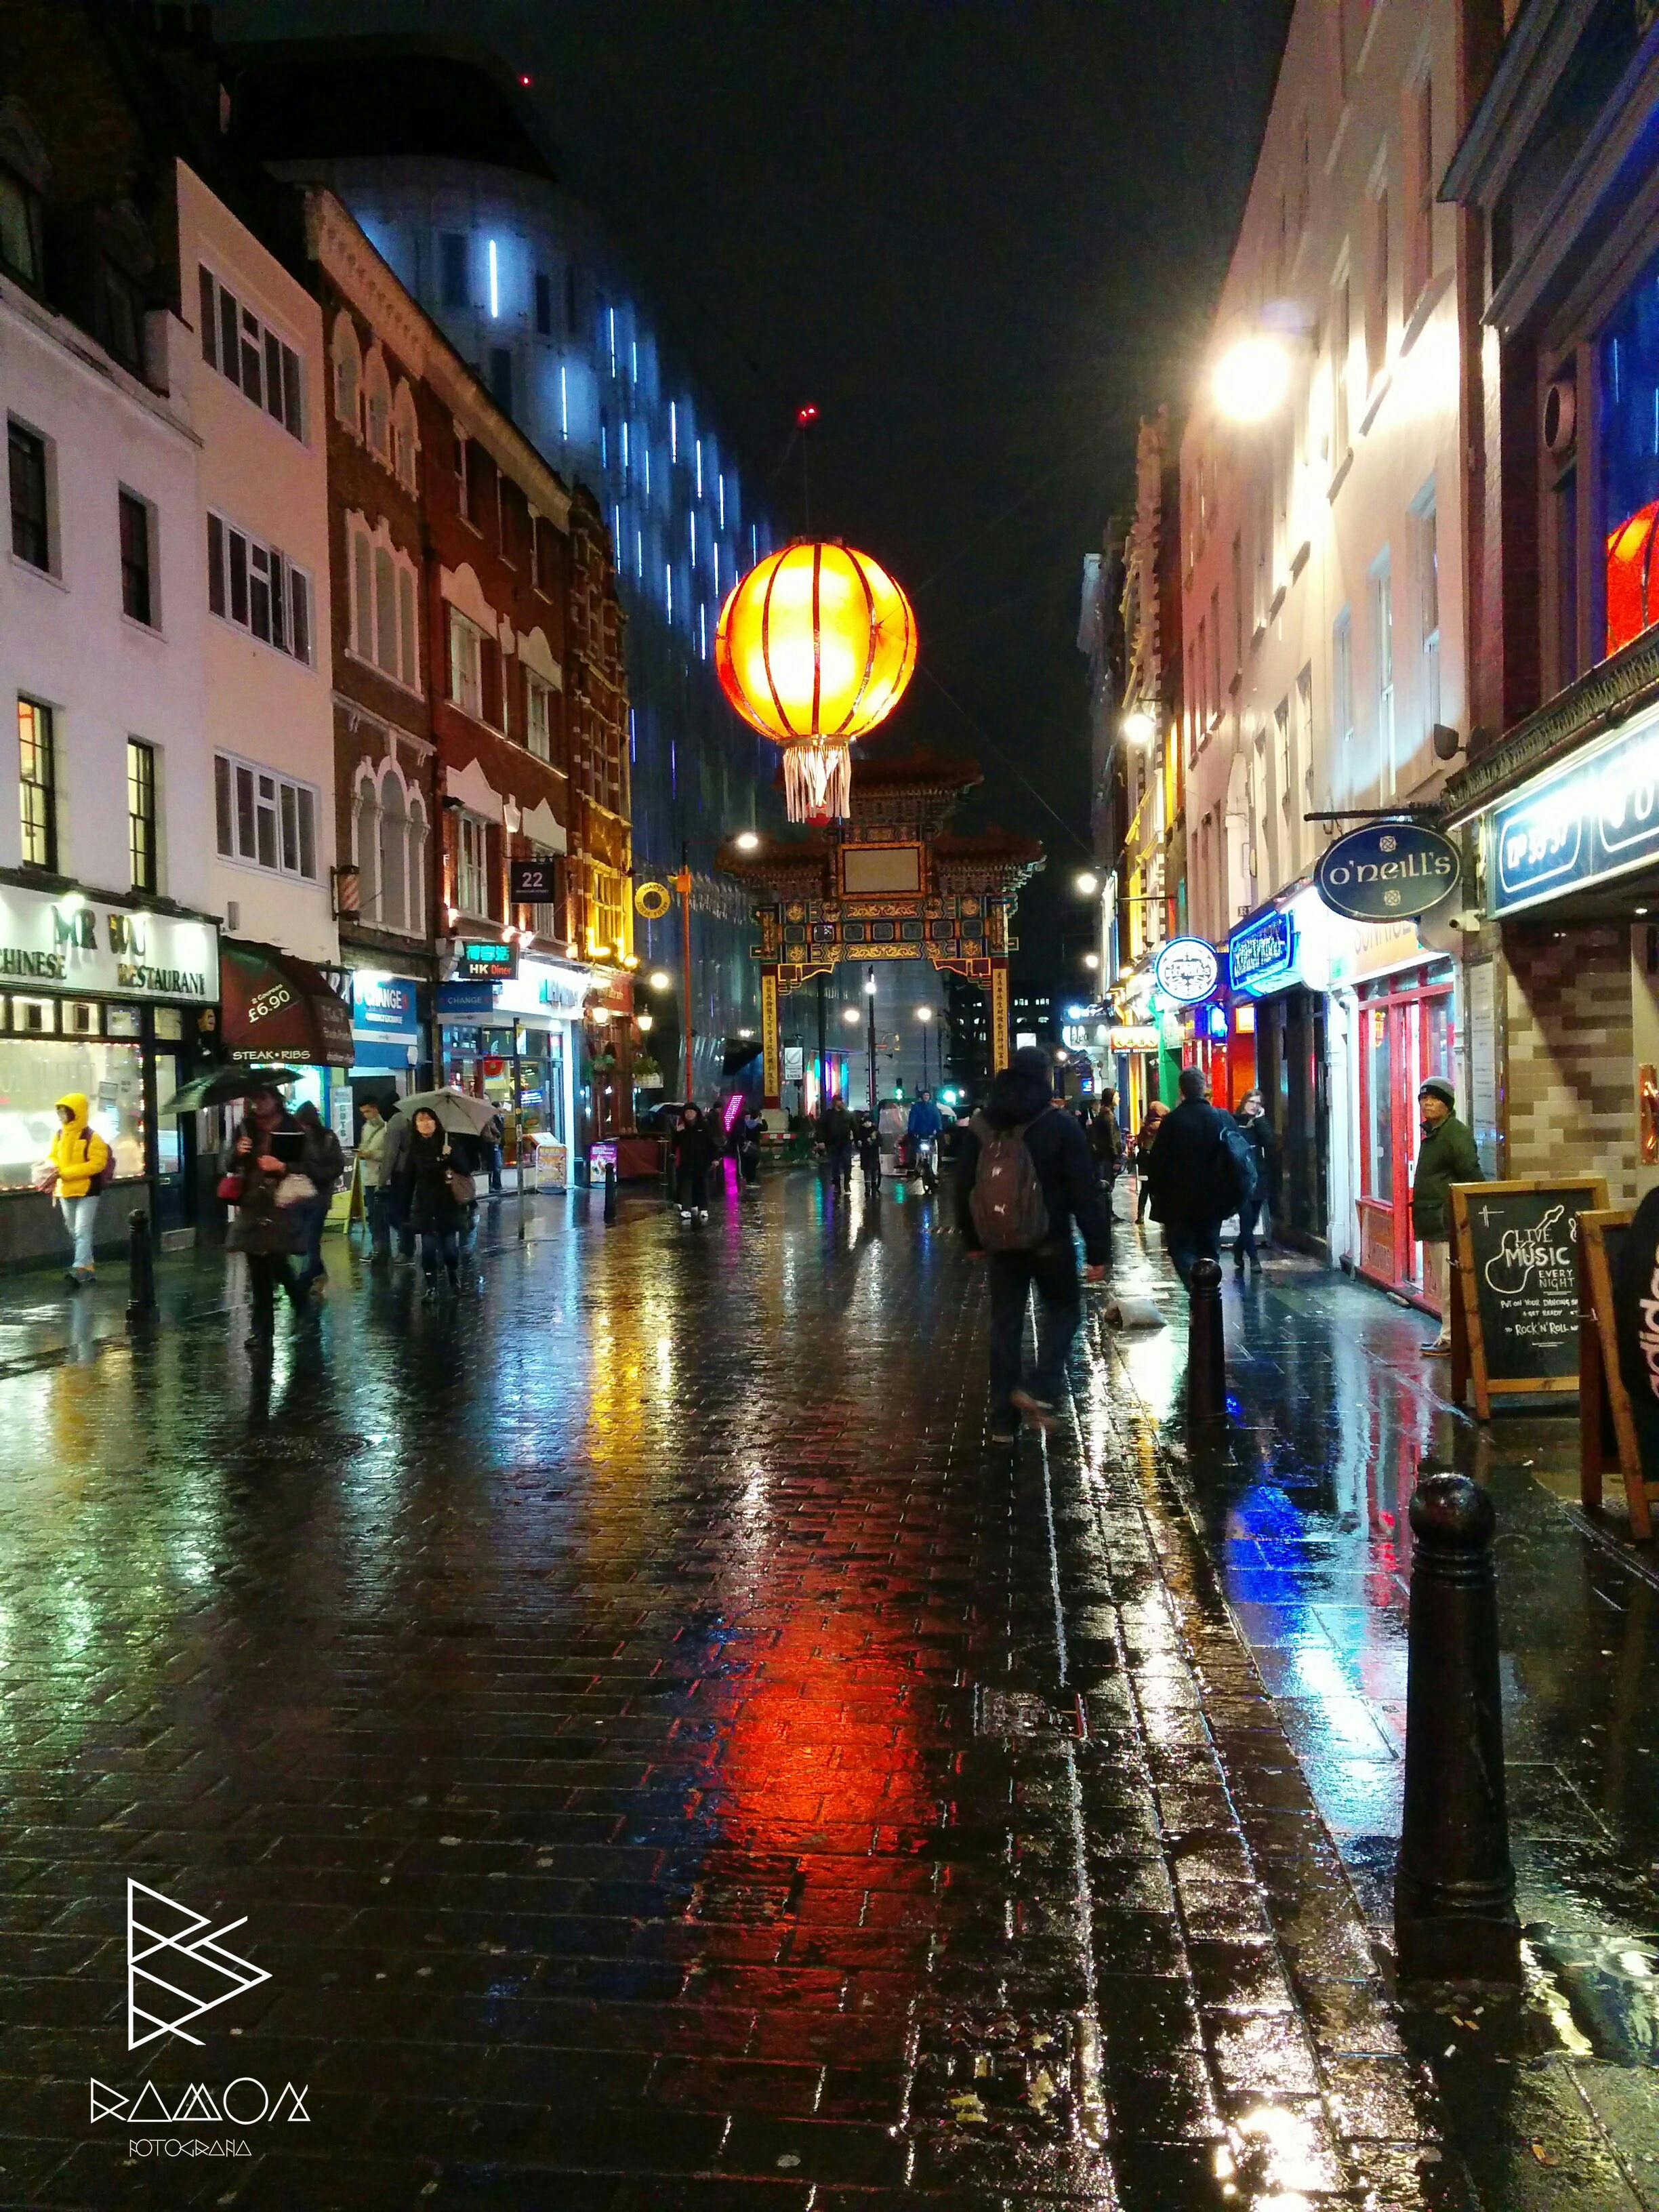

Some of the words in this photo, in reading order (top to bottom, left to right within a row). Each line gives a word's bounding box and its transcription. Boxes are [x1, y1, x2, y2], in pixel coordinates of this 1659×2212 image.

[522, 872, 543, 887] 22
[51, 905, 98, 949] MR
[0, 947, 67, 980] HINESE
[117, 963, 205, 996] RESTAURANT
[469, 964, 489, 975] HK
[491, 965, 512, 975] Diner
[248, 989, 290, 1023] £6.90
[447, 996, 483, 1004] CHANGE
[232, 1050, 274, 1061] STEAK
[281, 1050, 311, 1060] RIBS
[1514, 1229, 1553, 1243] LIVE
[1505, 1247, 1571, 1268] MUSIC
[1538, 1269, 1573, 1278] EVERY
[1539, 1277, 1575, 1290] NIGHT
[1500, 1300, 1512, 1309] PUT
[1542, 1298, 1570, 1307] DANCING
